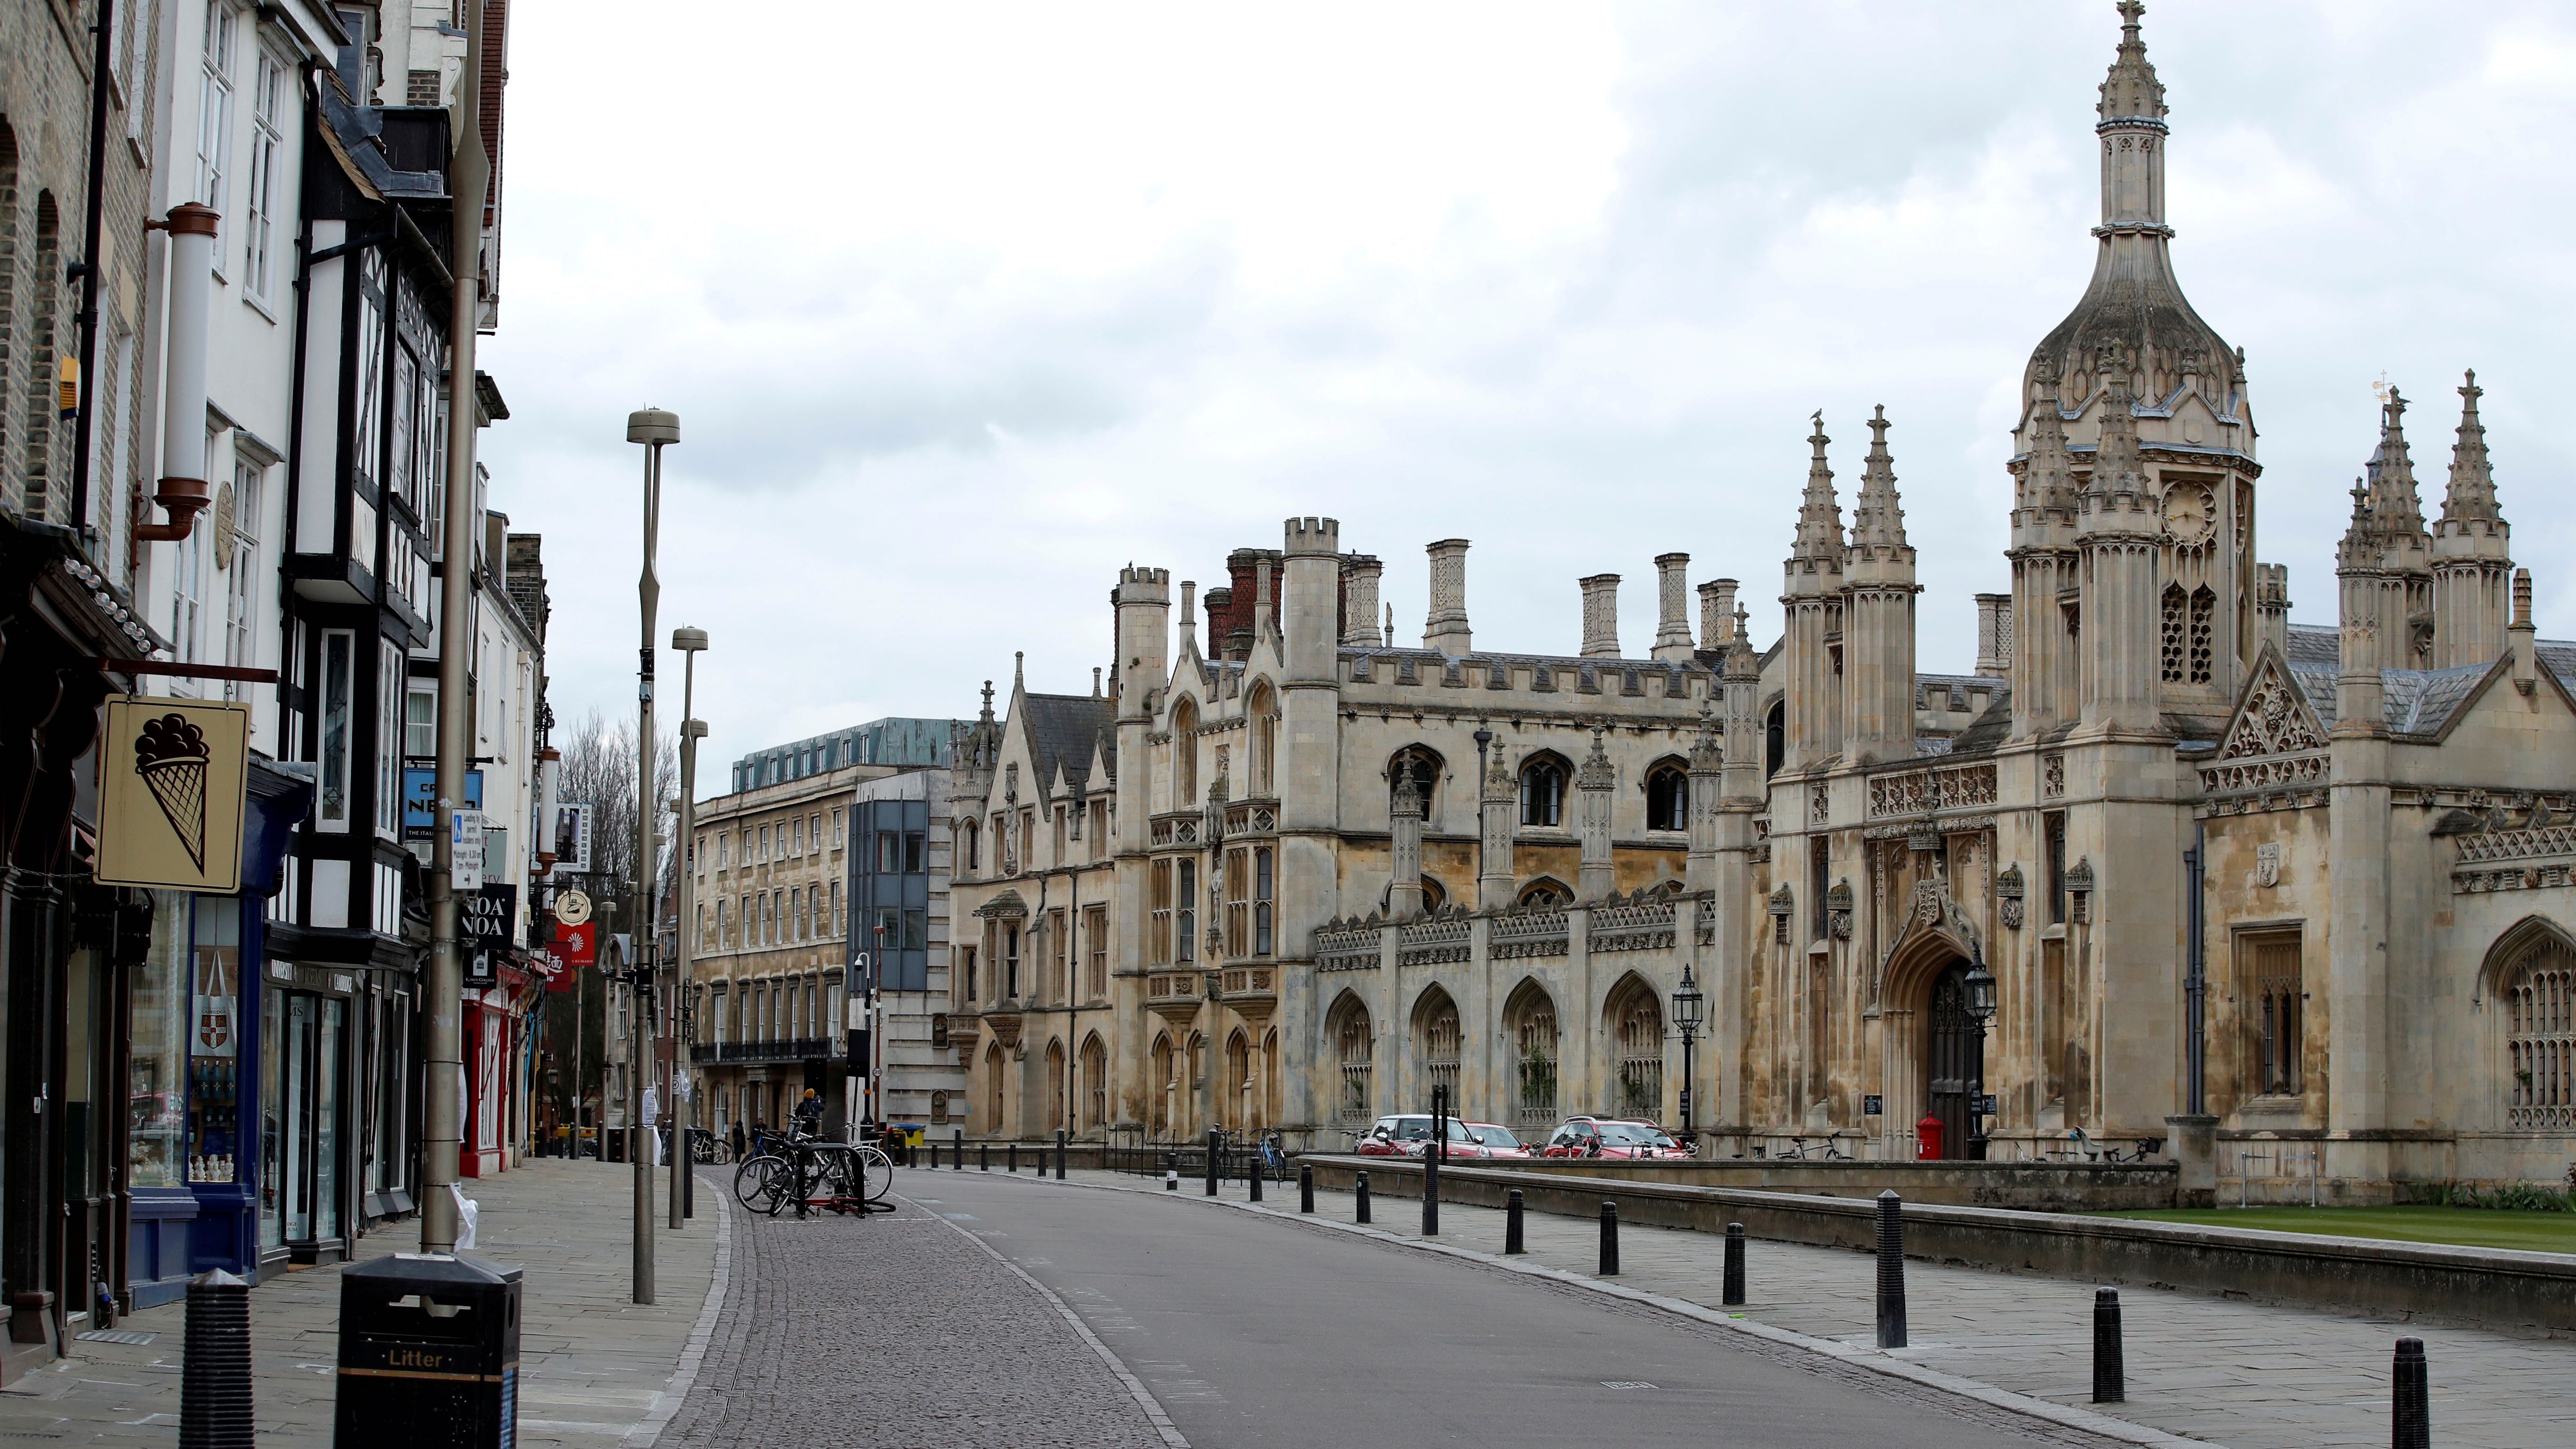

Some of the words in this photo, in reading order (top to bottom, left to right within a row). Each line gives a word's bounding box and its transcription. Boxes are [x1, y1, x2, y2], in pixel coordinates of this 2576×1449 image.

[464, 813, 475, 823] Loading
[467, 826, 477, 834] permit
[463, 837, 474, 845] holders
[453, 850, 467, 860] Midnight
[466, 861, 479, 871] Midnight
[462, 916, 503, 936] NOA
[272, 959, 293, 981] UNIVERSITY
[389, 1349, 443, 1367] Litter
